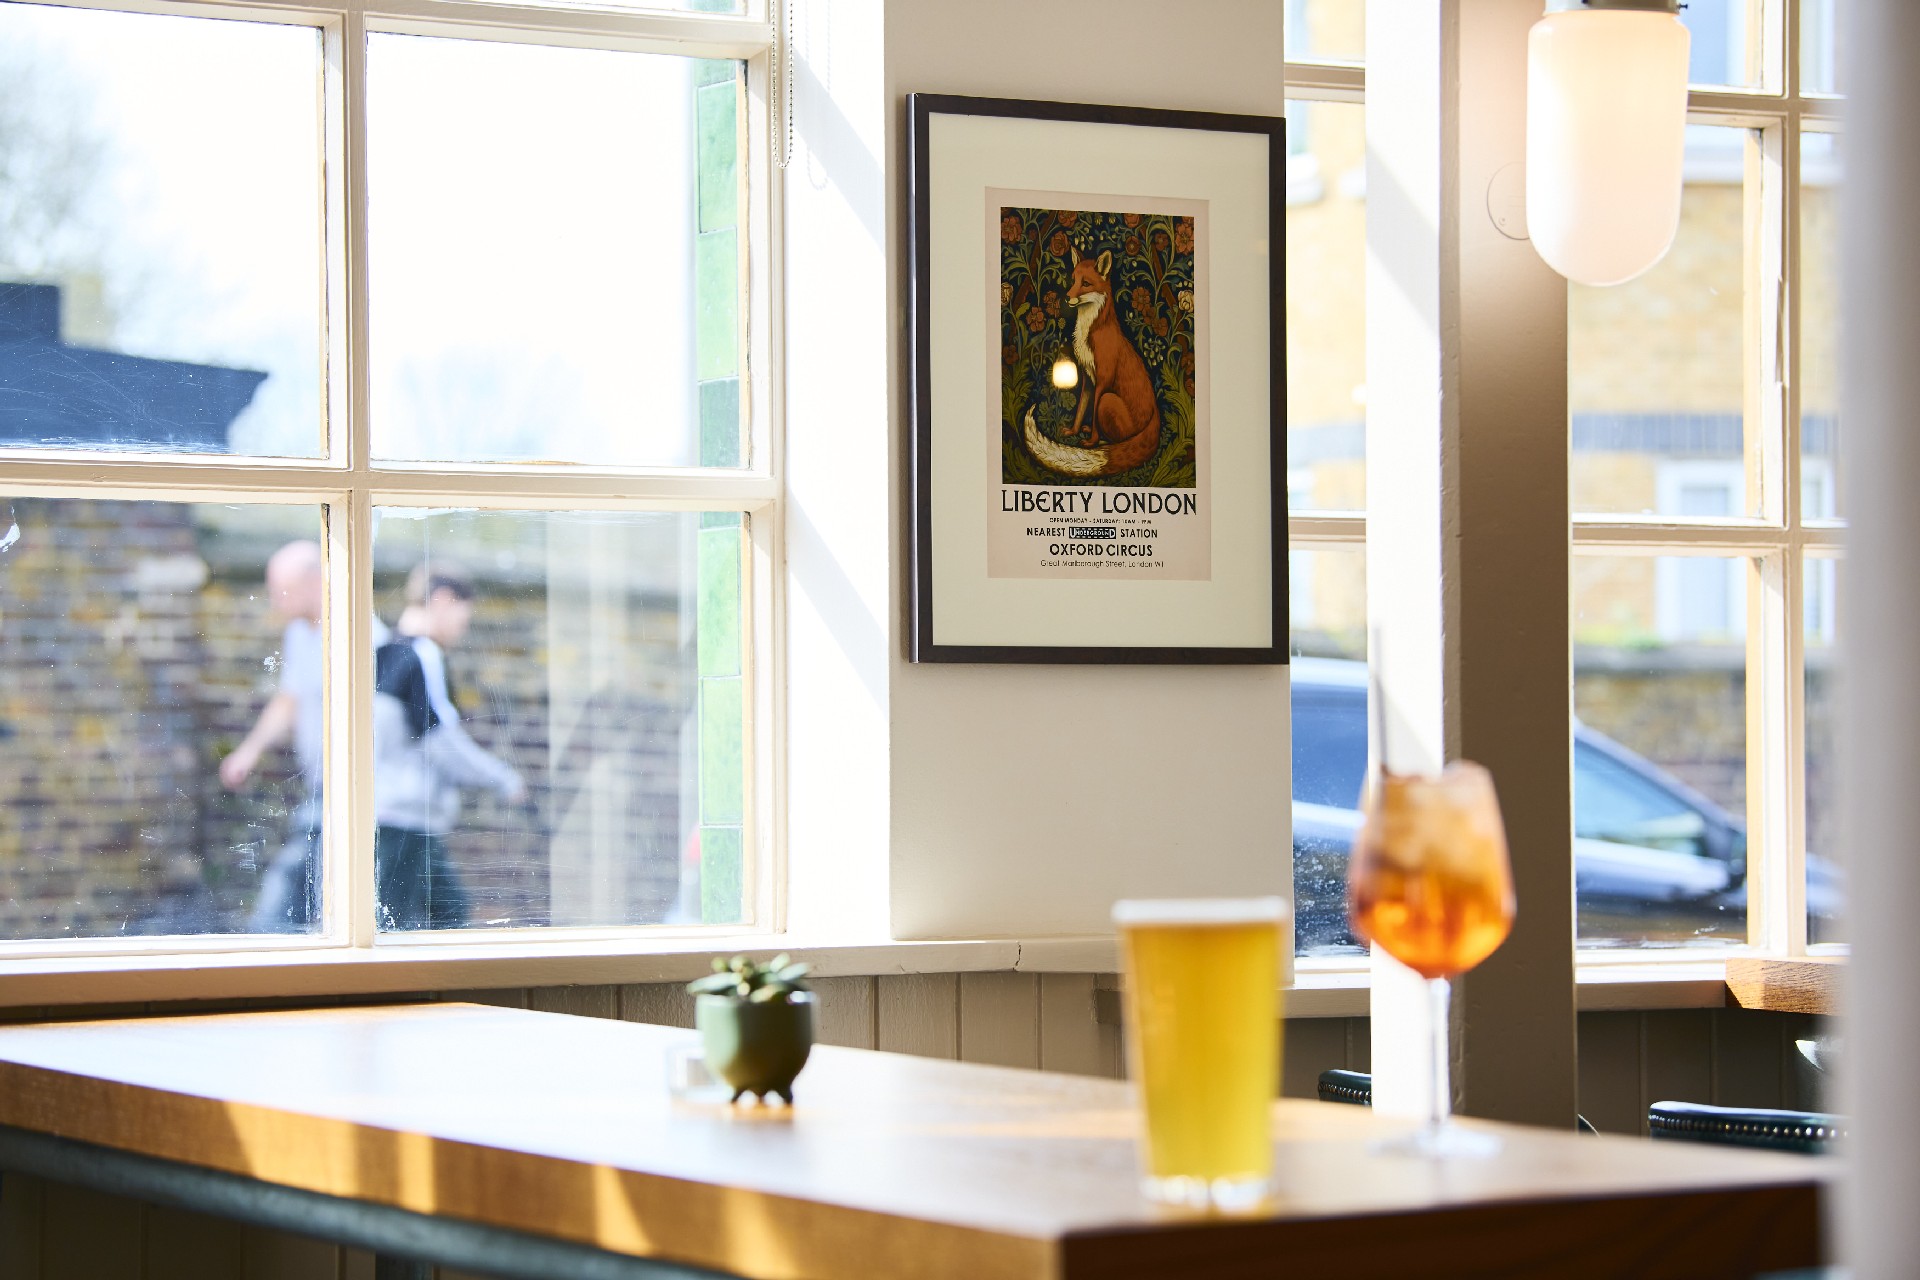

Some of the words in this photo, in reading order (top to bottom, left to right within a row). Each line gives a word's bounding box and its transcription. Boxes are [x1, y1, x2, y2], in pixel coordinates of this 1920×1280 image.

[1001, 489, 1093, 513] LIBERTY
[1102, 492, 1197, 515] LONDON
[1026, 527, 1066, 537] NEAREST
[1120, 528, 1158, 538] STATION
[1049, 543, 1104, 556] OXFORD
[1105, 544, 1153, 557] CIRCUS
[1040, 559, 1060, 567] Great
